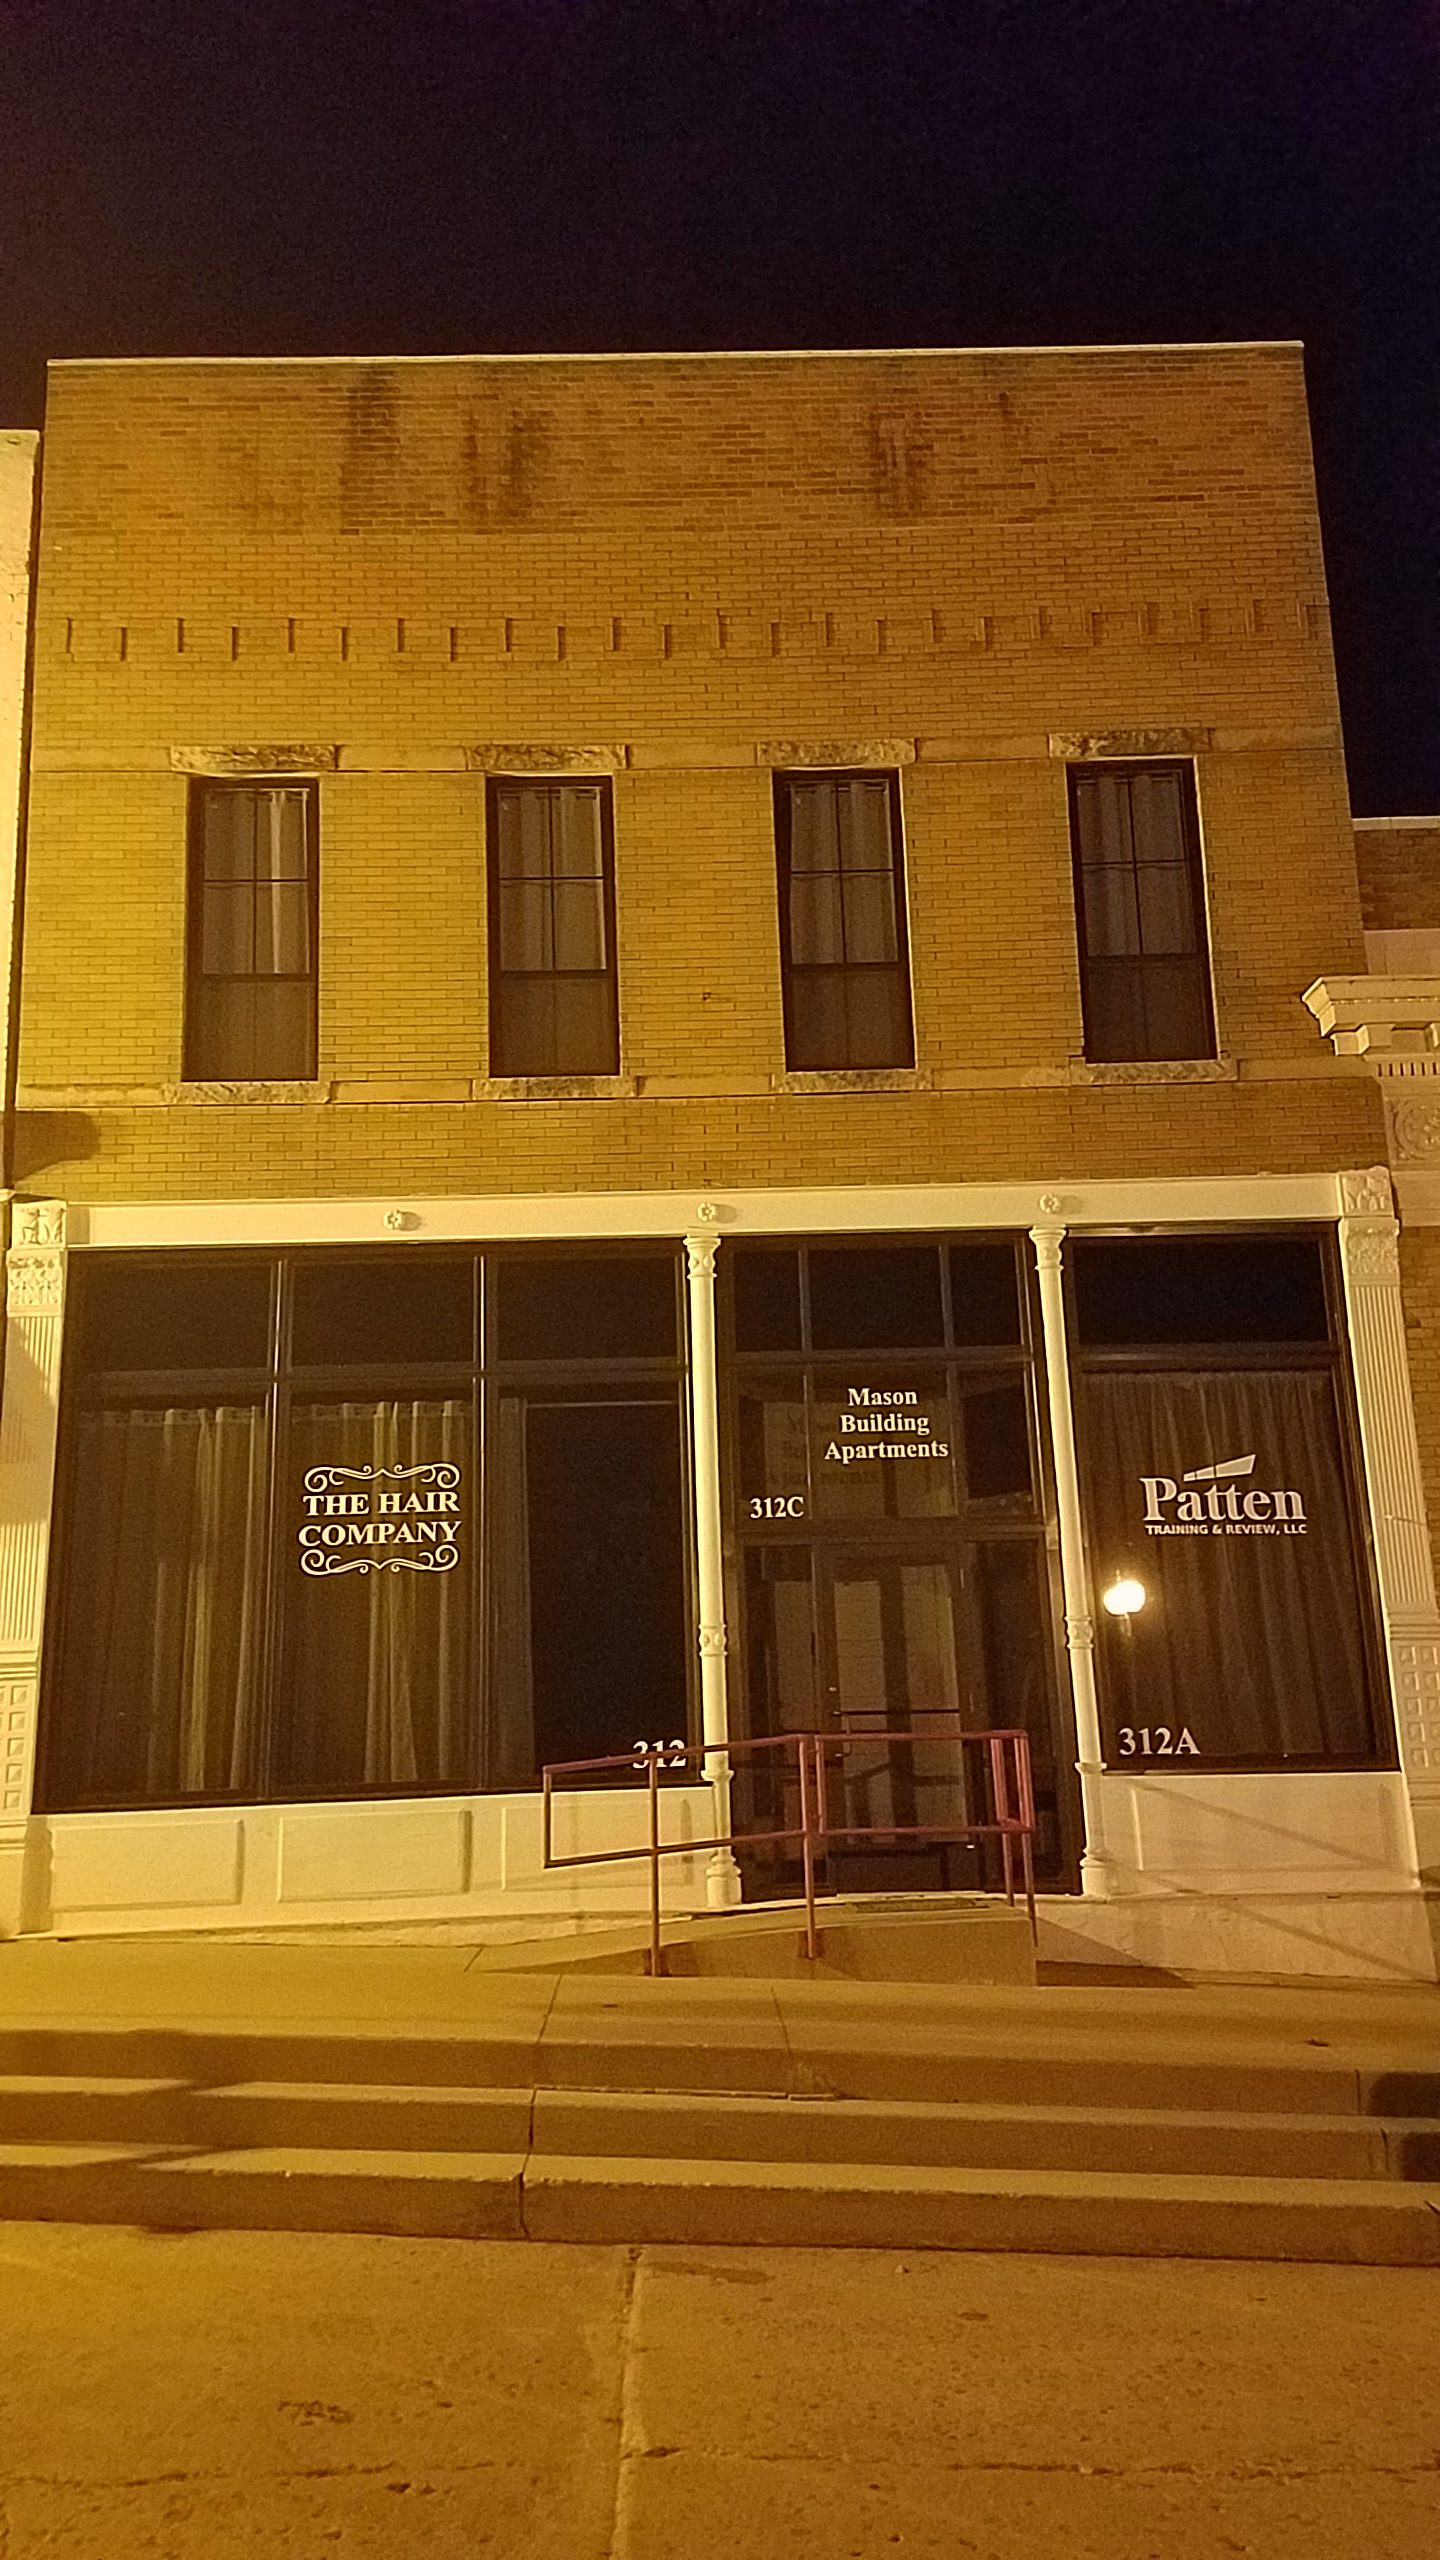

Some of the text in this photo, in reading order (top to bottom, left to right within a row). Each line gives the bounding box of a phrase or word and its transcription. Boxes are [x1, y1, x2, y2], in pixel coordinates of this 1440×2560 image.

[847, 1387, 918, 1407] Mason
[840, 1413, 931, 1436] Building
[824, 1440, 949, 1465] Apartments
[302, 1491, 460, 1516] THE HAIR
[749, 1496, 805, 1519] 312C
[1139, 1477, 1308, 1522] Patten
[298, 1520, 462, 1547] COMPANY
[1145, 1523, 1308, 1536] TRAINING & REVIEW, LLC
[1118, 1726, 1201, 1756] 312A
[632, 1739, 687, 1769] 312
